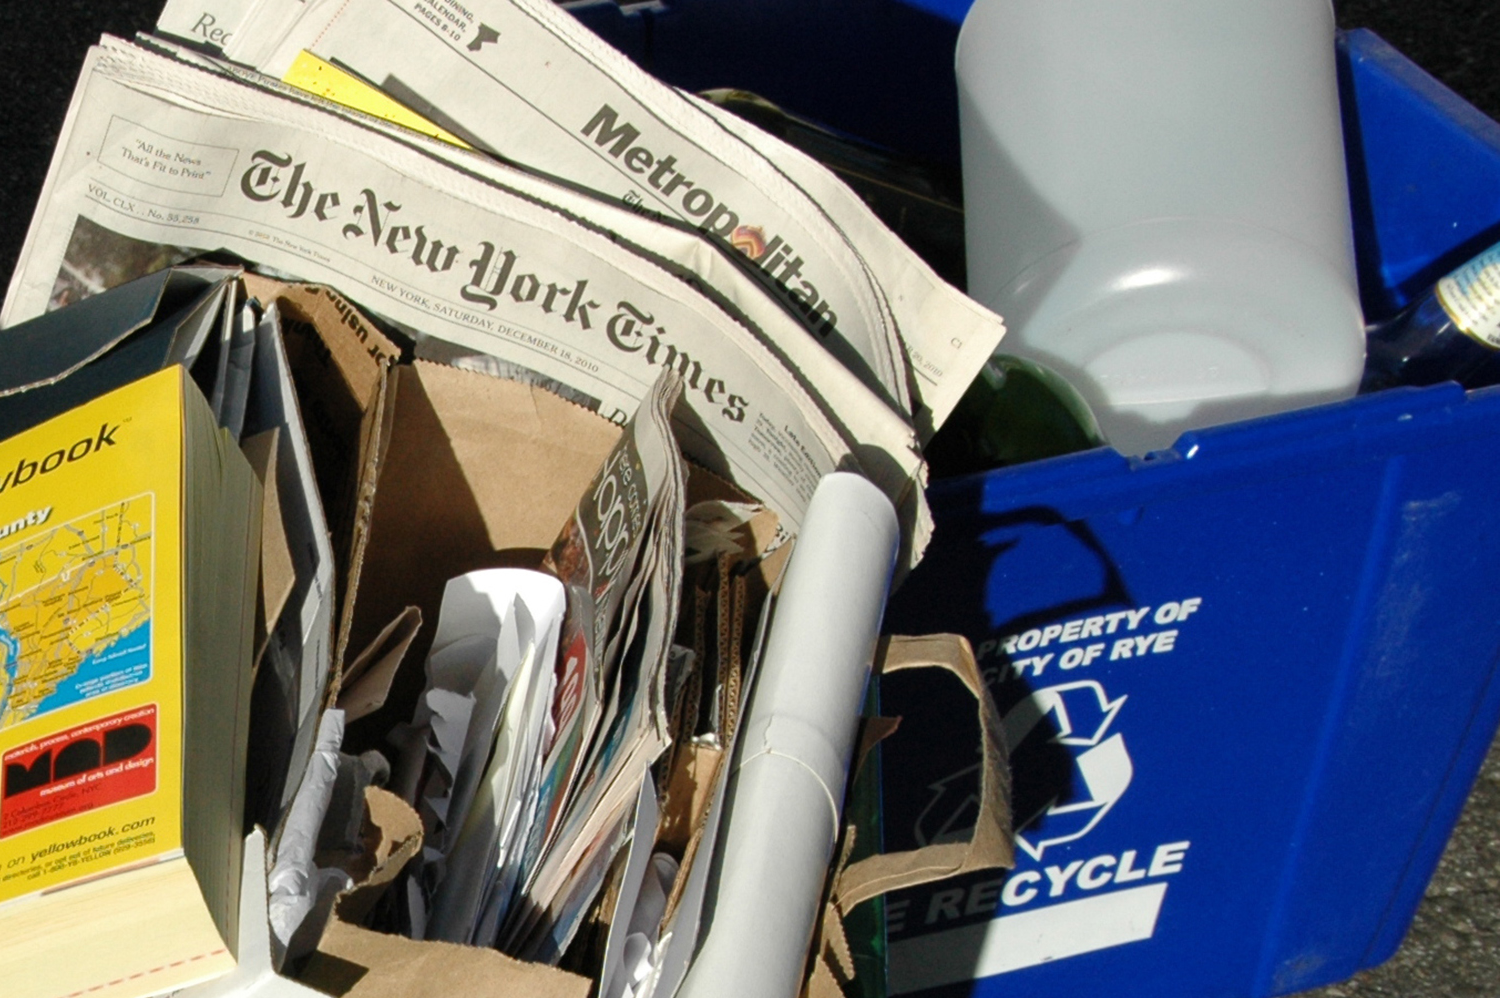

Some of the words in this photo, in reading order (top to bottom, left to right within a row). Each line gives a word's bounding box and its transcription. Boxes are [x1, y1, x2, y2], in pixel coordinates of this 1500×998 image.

[413, 3, 442, 27] PAGES
[422, 0, 467, 33] ALENDAR,
[121, 146, 151, 169] That's
[152, 159, 168, 174] Fit
[169, 164, 179, 176] to
[155, 146, 172, 162] the
[174, 152, 202, 167] News
[580, 103, 839, 339] Metropolitan
[240, 149, 341, 222] The
[342, 188, 460, 276] New
[460, 240, 602, 331] York
[606, 300, 750, 424] Times
[370, 274, 398, 293] NEW
[399, 287, 431, 310] YORK,
[432, 301, 495, 332] SATURDAY,
[497, 324, 560, 354] DECEMBER
[559, 349, 574, 363] 18,
[574, 356, 600, 374] 2010
[977, 606, 1151, 661] PROPERTY
[1153, 596, 1203, 624] OF
[982, 652, 1054, 689] CITY
[1058, 642, 1105, 672] OF
[1109, 628, 1179, 662] RYE
[122, 707, 156, 723] creation
[39, 780, 76, 798] museum
[76, 773, 88, 786] of
[87, 770, 105, 783] arts
[105, 763, 125, 777] and
[124, 756, 156, 773] design
[7, 855, 26, 870] on
[30, 814, 157, 863] yellowbook.com
[922, 839, 1191, 926] RECYCLE
